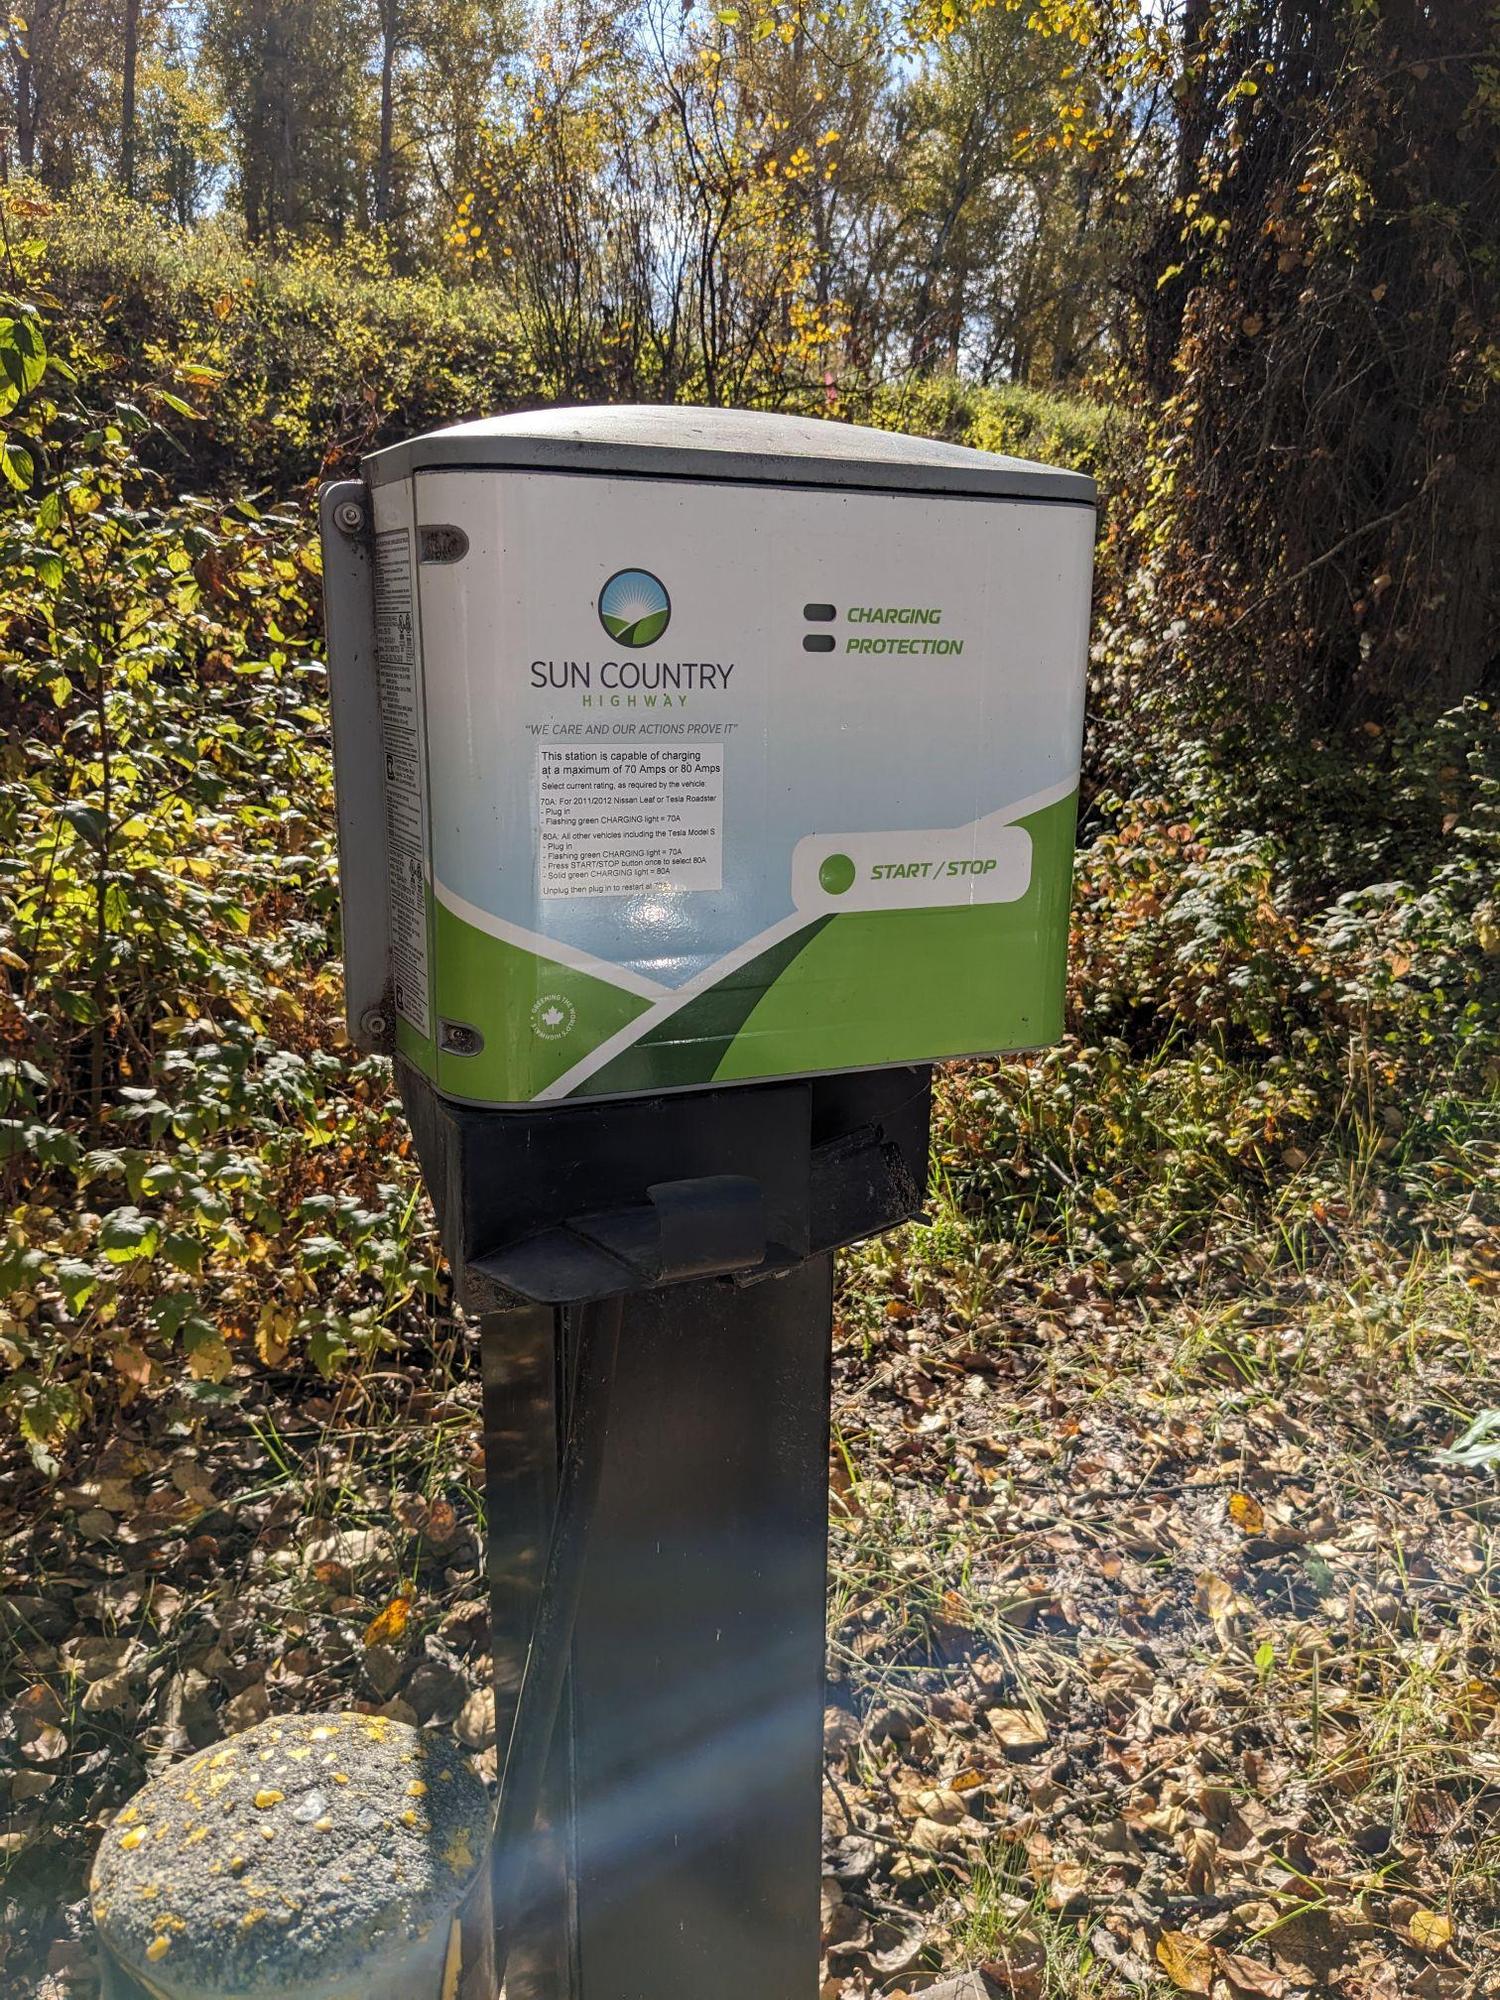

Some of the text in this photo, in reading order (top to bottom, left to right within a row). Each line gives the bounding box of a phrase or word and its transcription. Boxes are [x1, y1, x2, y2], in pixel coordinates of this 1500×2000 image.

[847, 607, 942, 624] CHARGING
[846, 638, 964, 655] PROTECTION
[530, 661, 734, 689] SUN COUNTRY
[583, 695, 688, 707] HIGHWAY
[525, 724, 738, 735] "WE CARE AND OUR ACTIONS PROVE IT"
[541, 752, 562, 760] This
[565, 752, 597, 760] station
[600, 752, 607, 760] is
[611, 752, 648, 761] capable
[662, 752, 700, 762] charging
[542, 766, 551, 774] at
[563, 765, 609, 774] maximum
[613, 765, 622, 774] of
[625, 765, 636, 773] 70
[640, 765, 666, 774] Amps
[681, 764, 692, 773] 80
[695, 764, 720, 774] Amps
[645, 815, 659, 823] light
[571, 860, 619, 868] START/STOP
[590, 869, 632, 877] CHARGING
[635, 868, 648, 876] light
